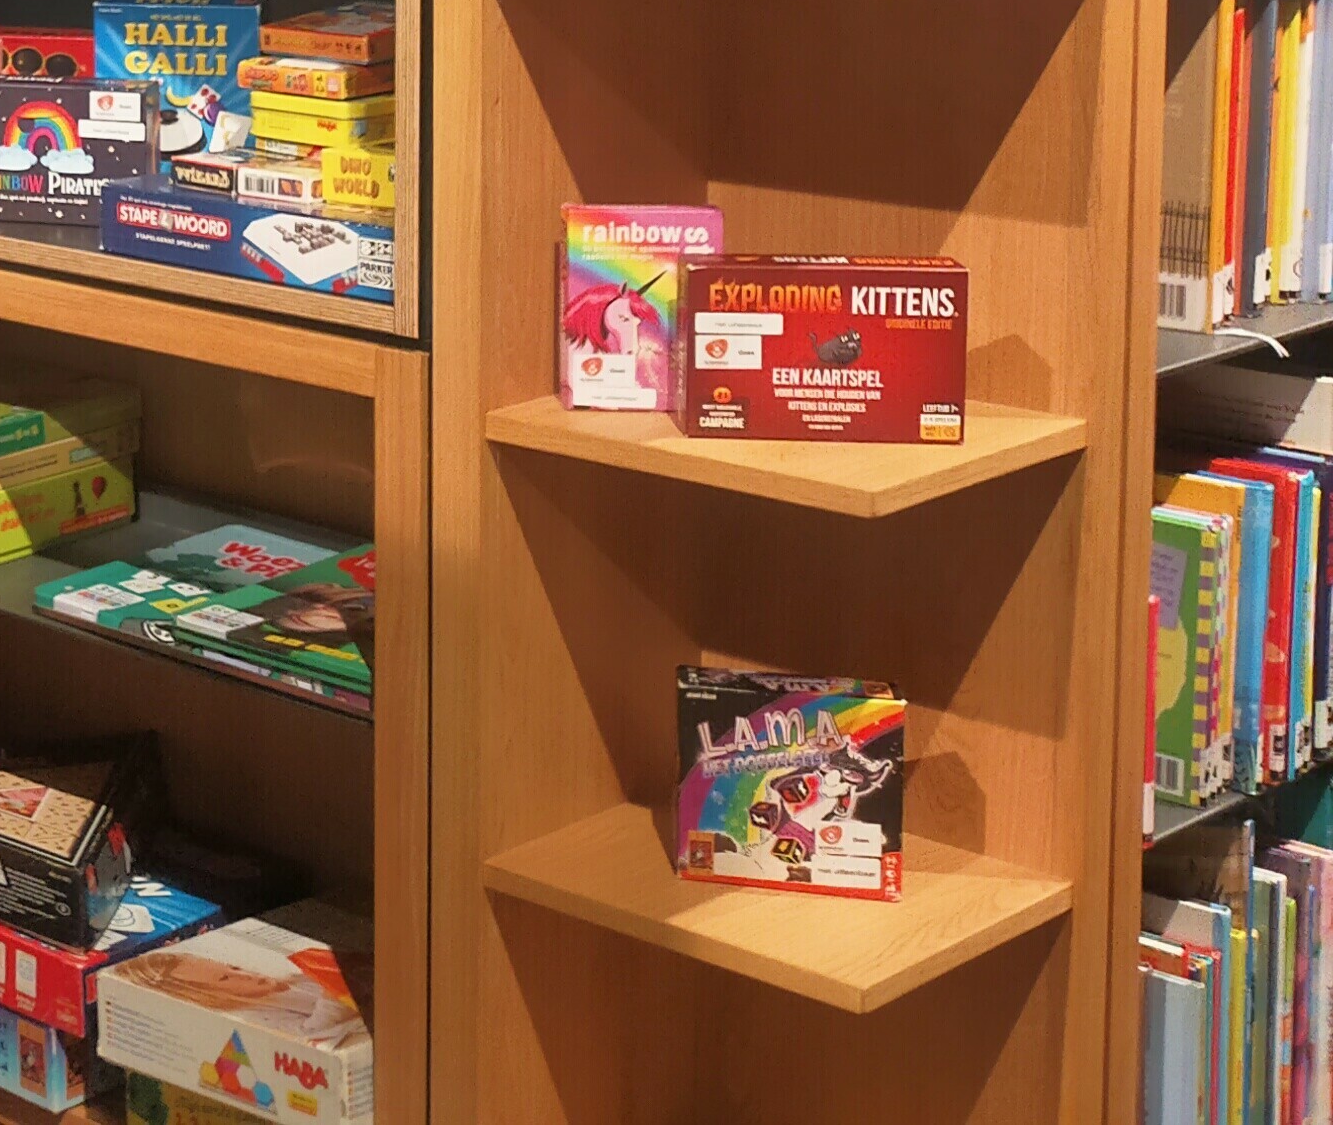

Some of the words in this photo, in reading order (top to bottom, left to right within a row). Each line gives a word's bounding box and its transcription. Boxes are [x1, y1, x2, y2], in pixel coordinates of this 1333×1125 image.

[124, 21, 228, 47] HALLI
[124, 50, 228, 76] GALLI
[340, 155, 372, 176] DINO
[333, 177, 380, 199] WORLD
[173, 213, 228, 238] WOORD
[582, 221, 682, 245] rainbow
[709, 280, 843, 313] EXPLODING
[851, 286, 956, 317] KITTENS
[773, 368, 800, 385] EEN
[802, 368, 884, 388] KAARTSPEL
[273, 1051, 329, 1090] HABA
